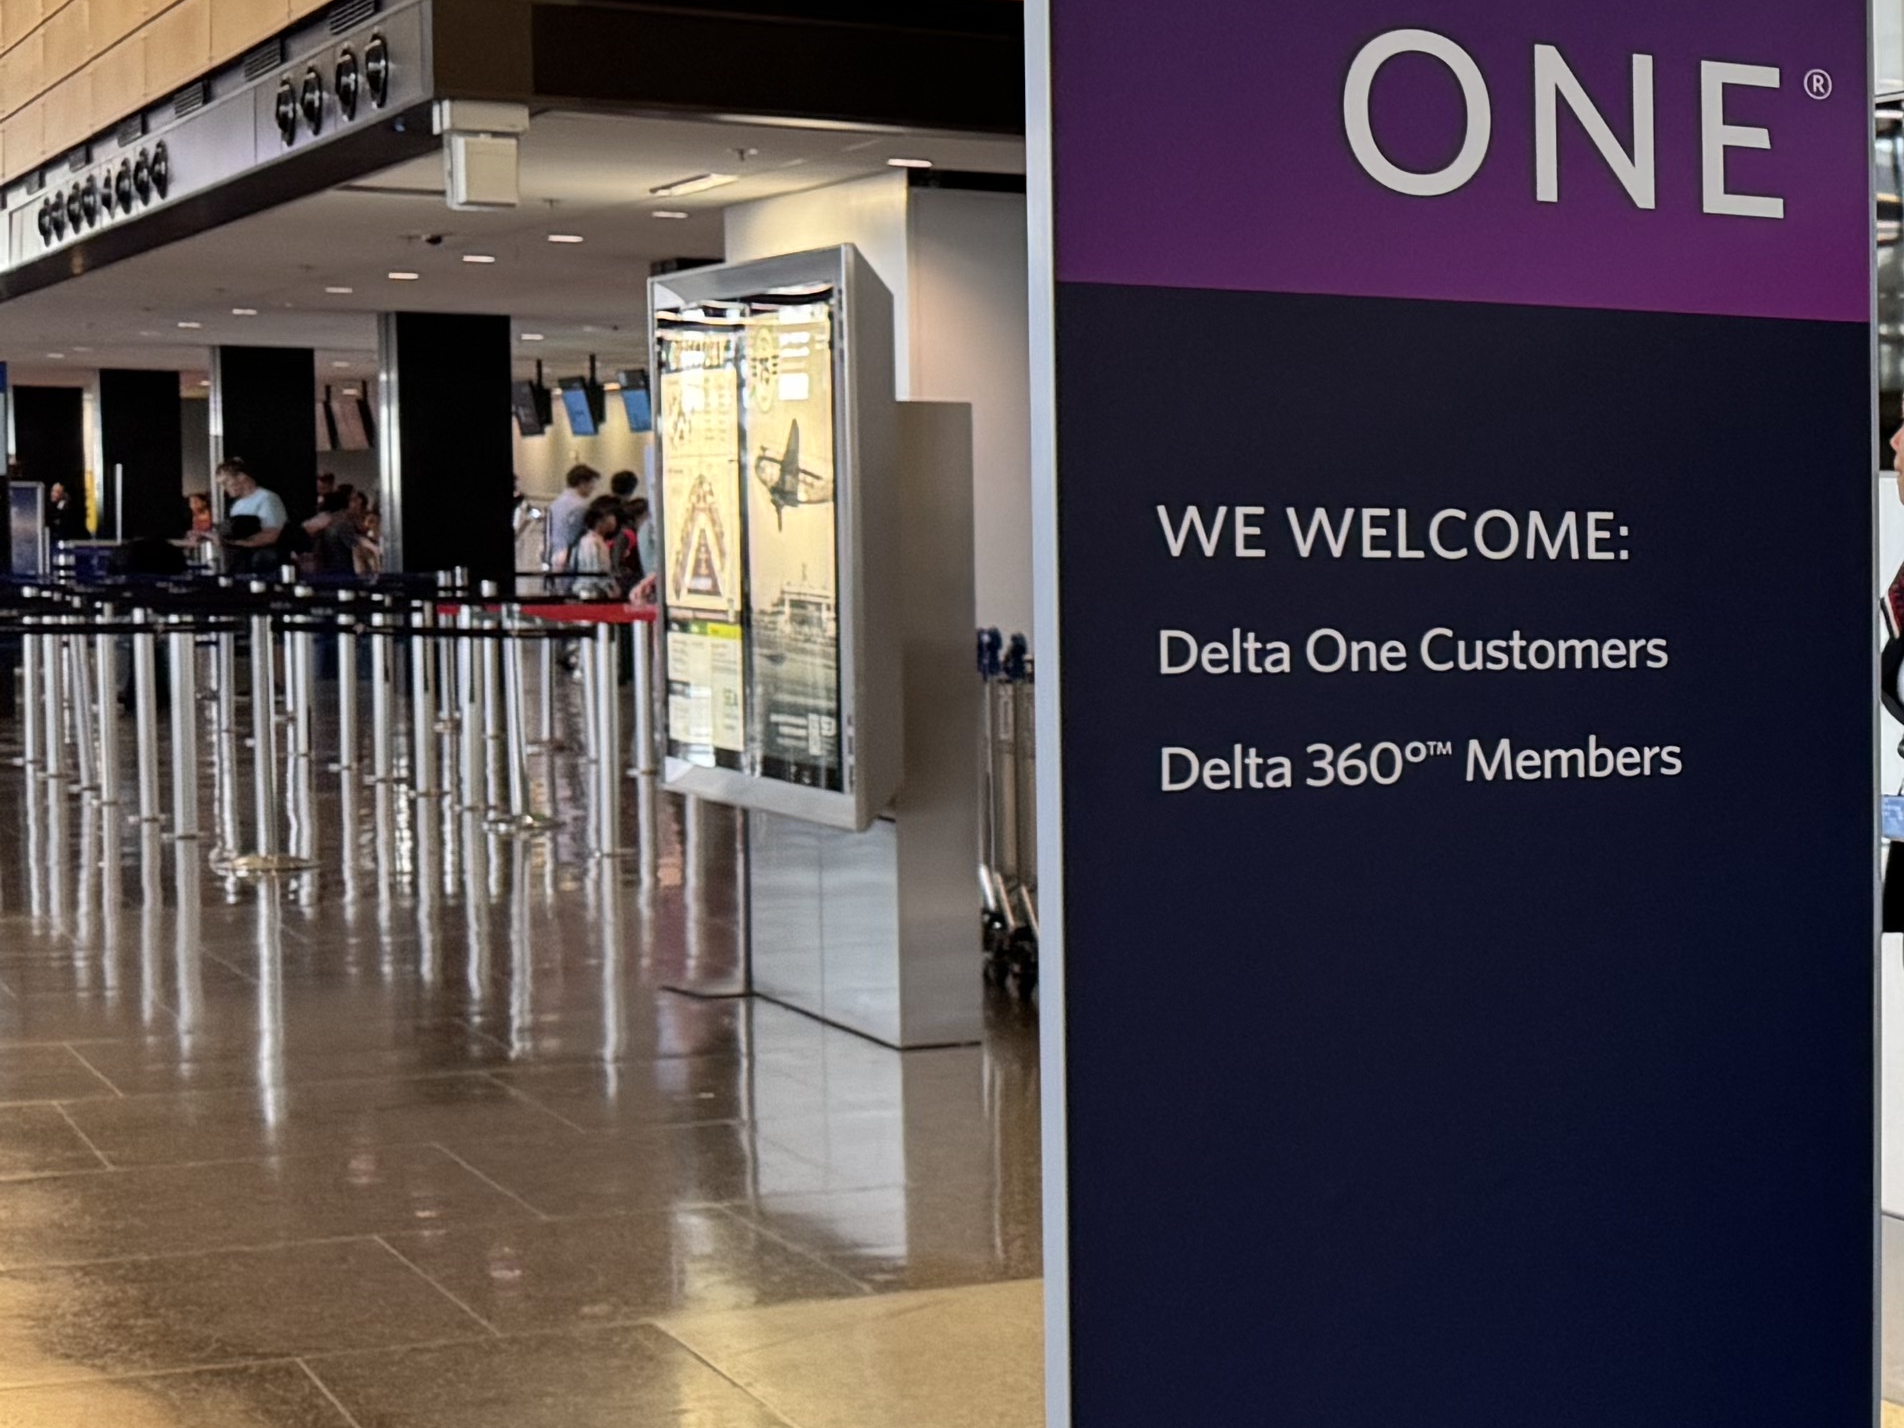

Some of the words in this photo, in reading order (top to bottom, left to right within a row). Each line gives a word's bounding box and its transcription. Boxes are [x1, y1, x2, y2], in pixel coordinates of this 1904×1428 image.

[1156, 504, 1266, 558] WE
[1286, 506, 1630, 561] WELCOME:
[1159, 627, 1291, 674] Delta
[1306, 628, 1407, 673] One
[1420, 627, 1669, 671] Customers
[1161, 743, 1292, 792] Delta
[1466, 734, 1682, 782] Members
